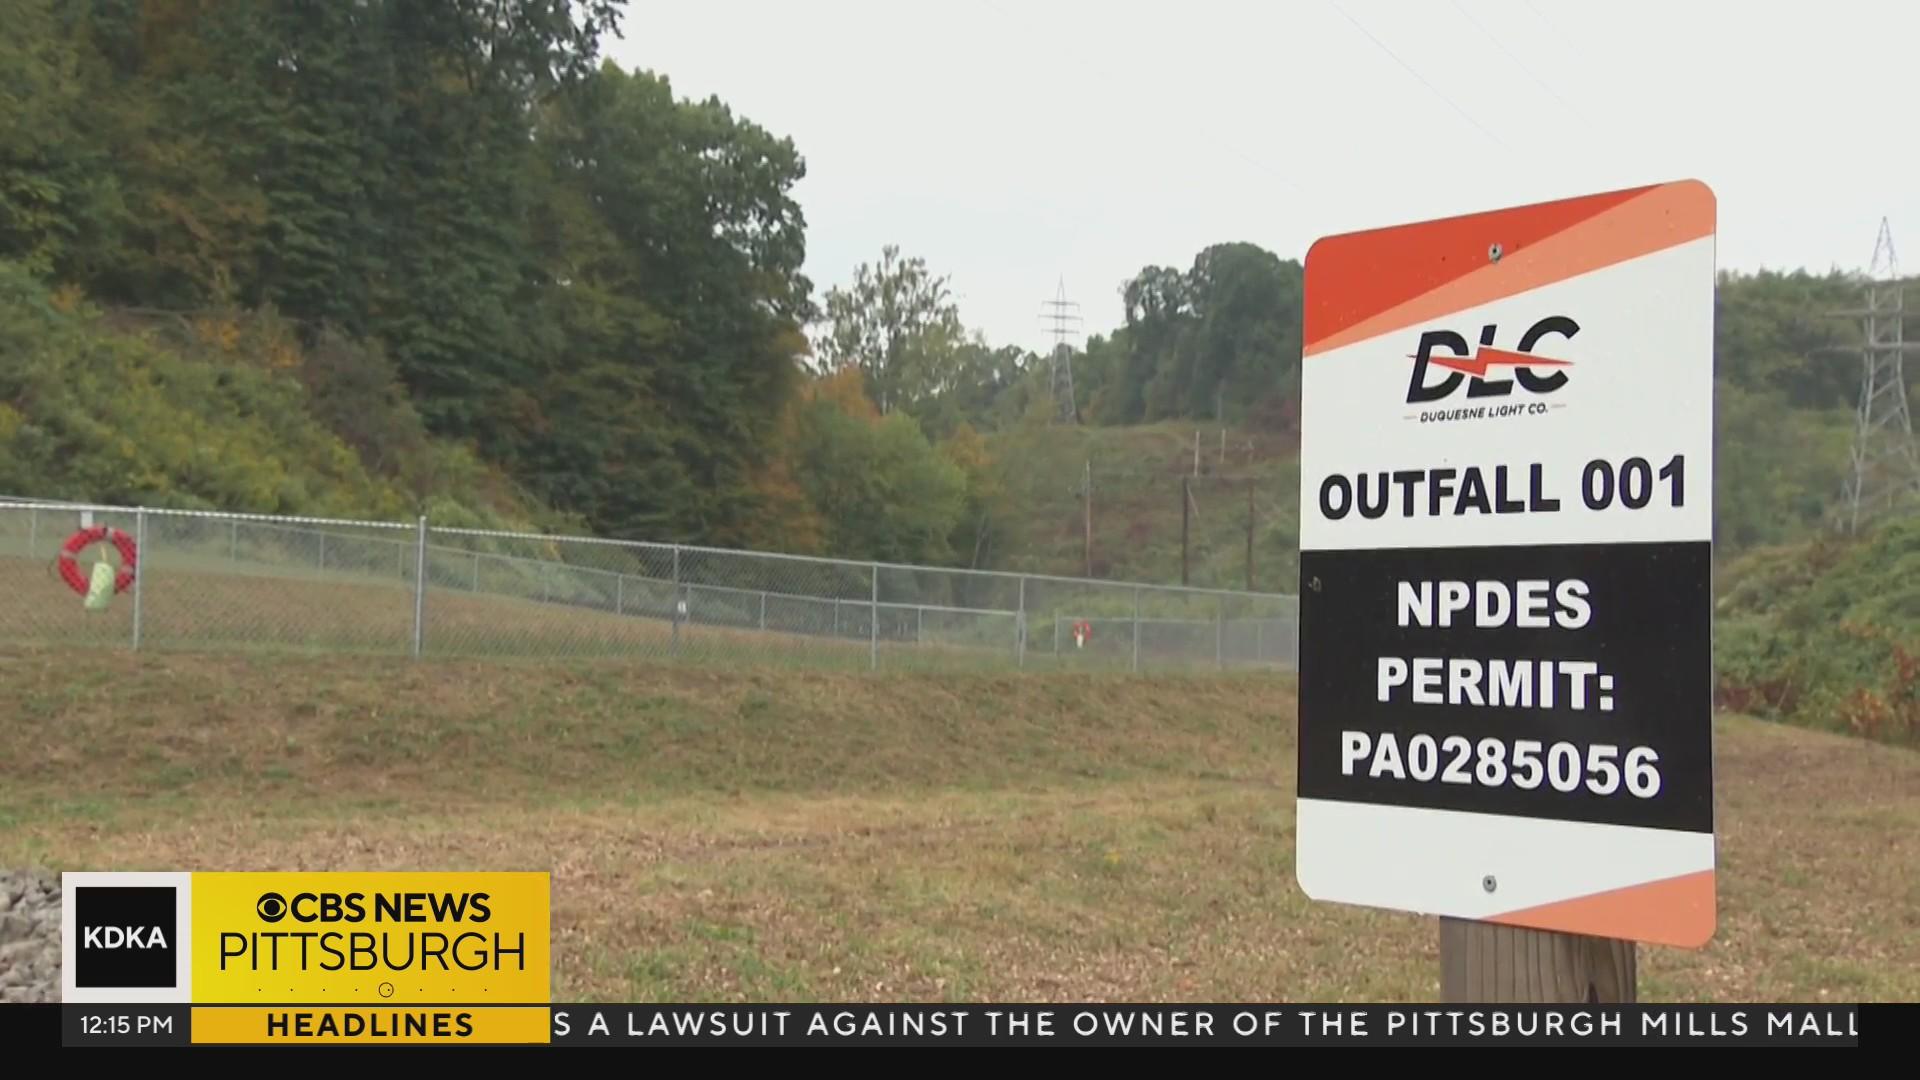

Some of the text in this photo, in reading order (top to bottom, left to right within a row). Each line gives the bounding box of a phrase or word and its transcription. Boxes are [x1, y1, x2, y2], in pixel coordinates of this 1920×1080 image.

[1406, 315, 1580, 404] DLC
[1420, 401, 1548, 423] DUQUESNE LIGHT CO.
[1319, 454, 1686, 520] OUTFALL 001
[1397, 579, 1592, 629] NPDES
[1377, 657, 1615, 711] PERMIT:
[1341, 730, 1661, 799] PA0285056
